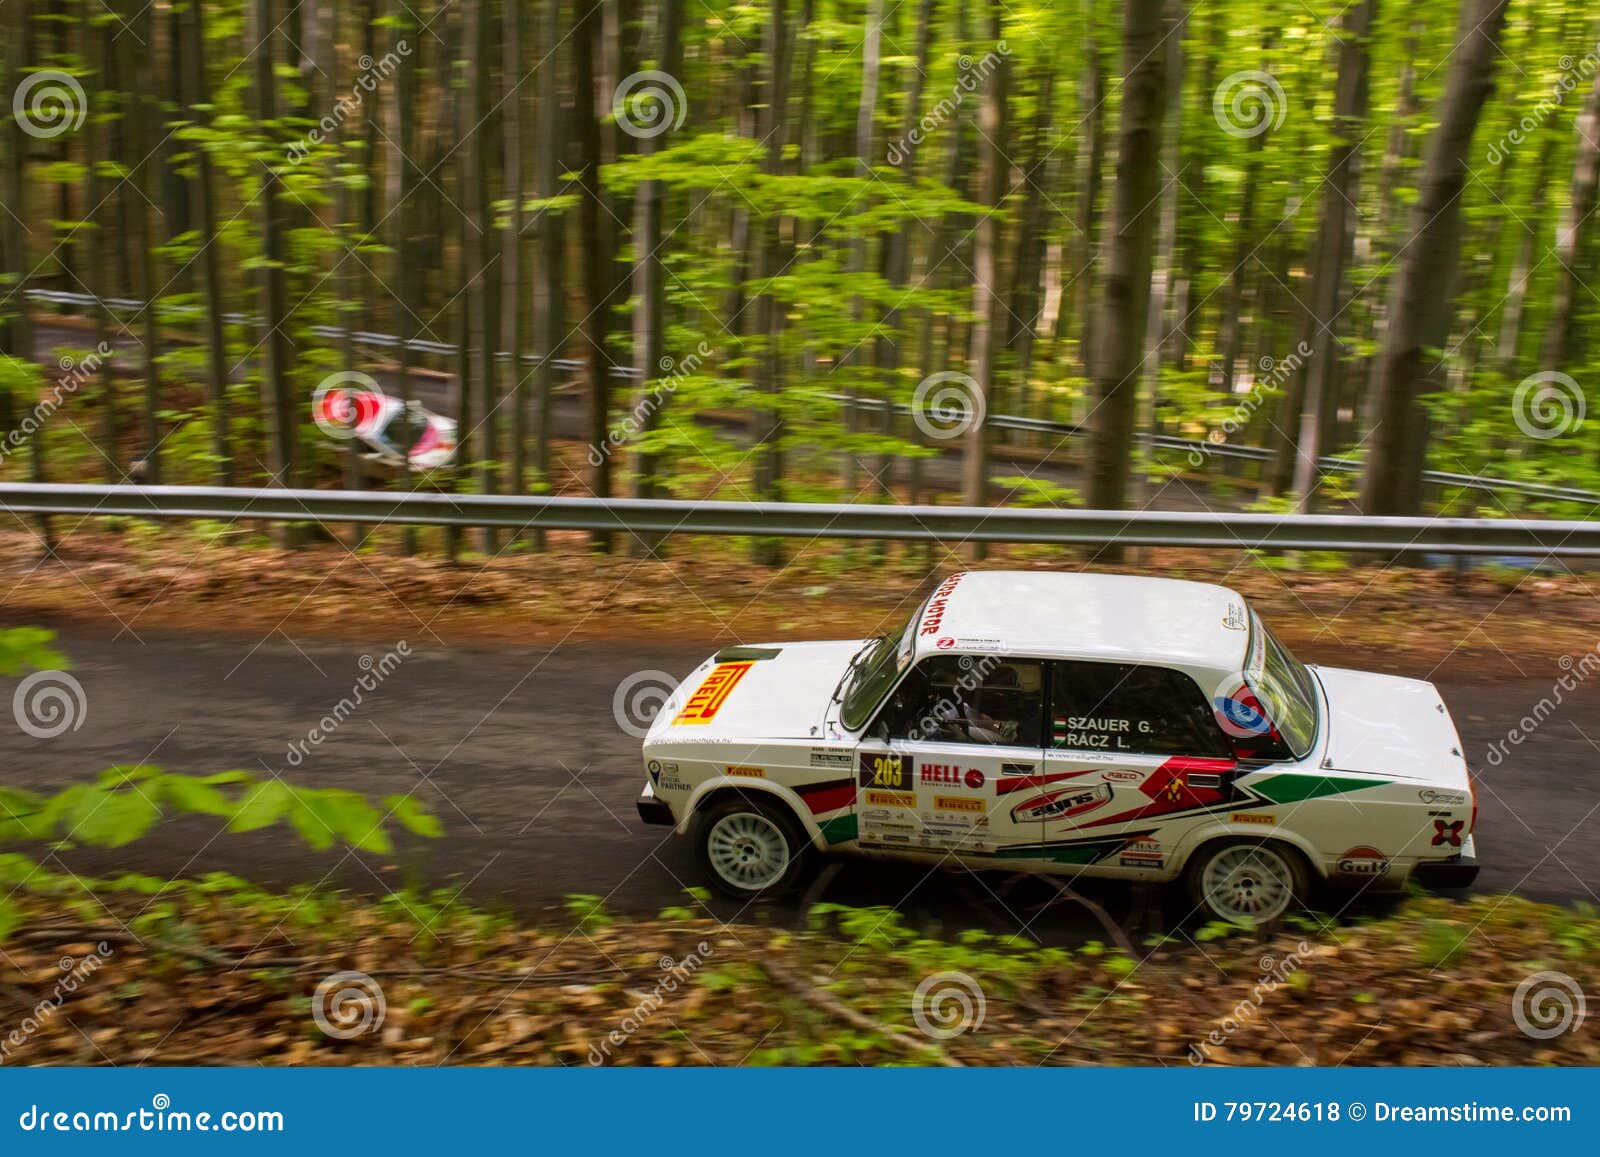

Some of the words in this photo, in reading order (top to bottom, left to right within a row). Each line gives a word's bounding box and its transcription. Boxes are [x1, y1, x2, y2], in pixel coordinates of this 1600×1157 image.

[678, 663, 753, 719] PIRELLI
[1067, 717, 1130, 732] SZAUER
[1138, 720, 1155, 733] G.
[1067, 732, 1109, 748] RÁCZ
[1117, 736, 1130, 749] L.
[873, 757, 902, 787] 203
[921, 763, 960, 783] HELL
[660, 782, 692, 791] PARTNER
[870, 793, 913, 806] PIRELLI
[938, 798, 982, 811] PIRELLI
[1338, 860, 1389, 874] Gulf
